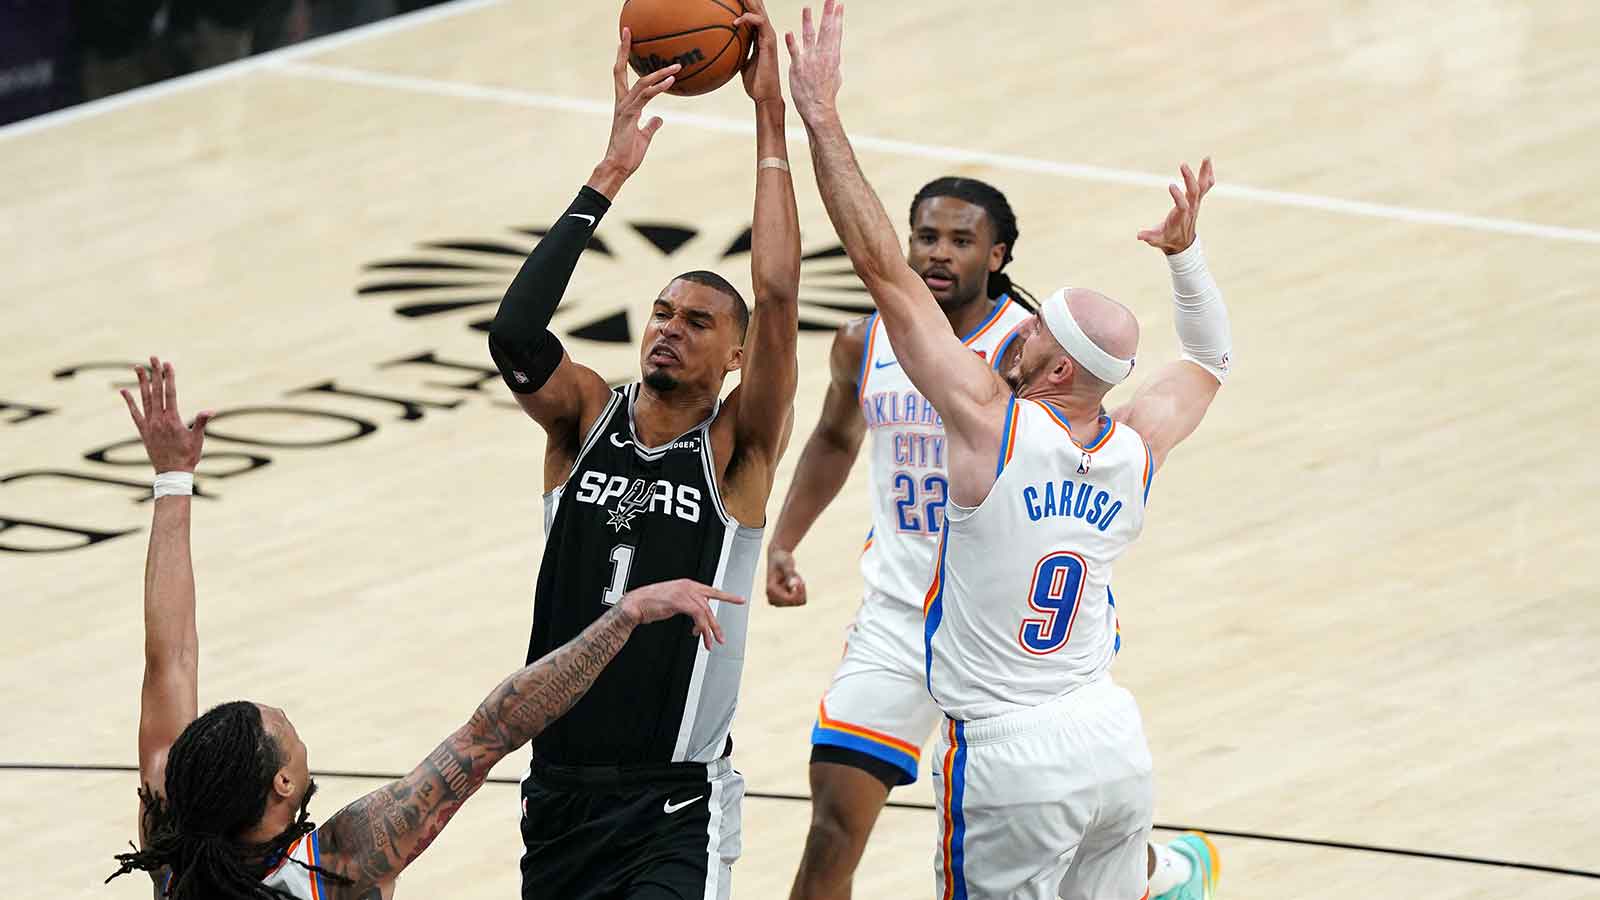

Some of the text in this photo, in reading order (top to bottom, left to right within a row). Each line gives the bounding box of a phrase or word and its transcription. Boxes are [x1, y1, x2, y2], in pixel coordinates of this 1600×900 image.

[892, 432, 944, 468] CITY
[576, 470, 701, 526] SPURS
[892, 471, 948, 536] 22
[1023, 480, 1123, 532] CARUSO
[601, 544, 636, 607] 1
[1018, 551, 1088, 655] 9
